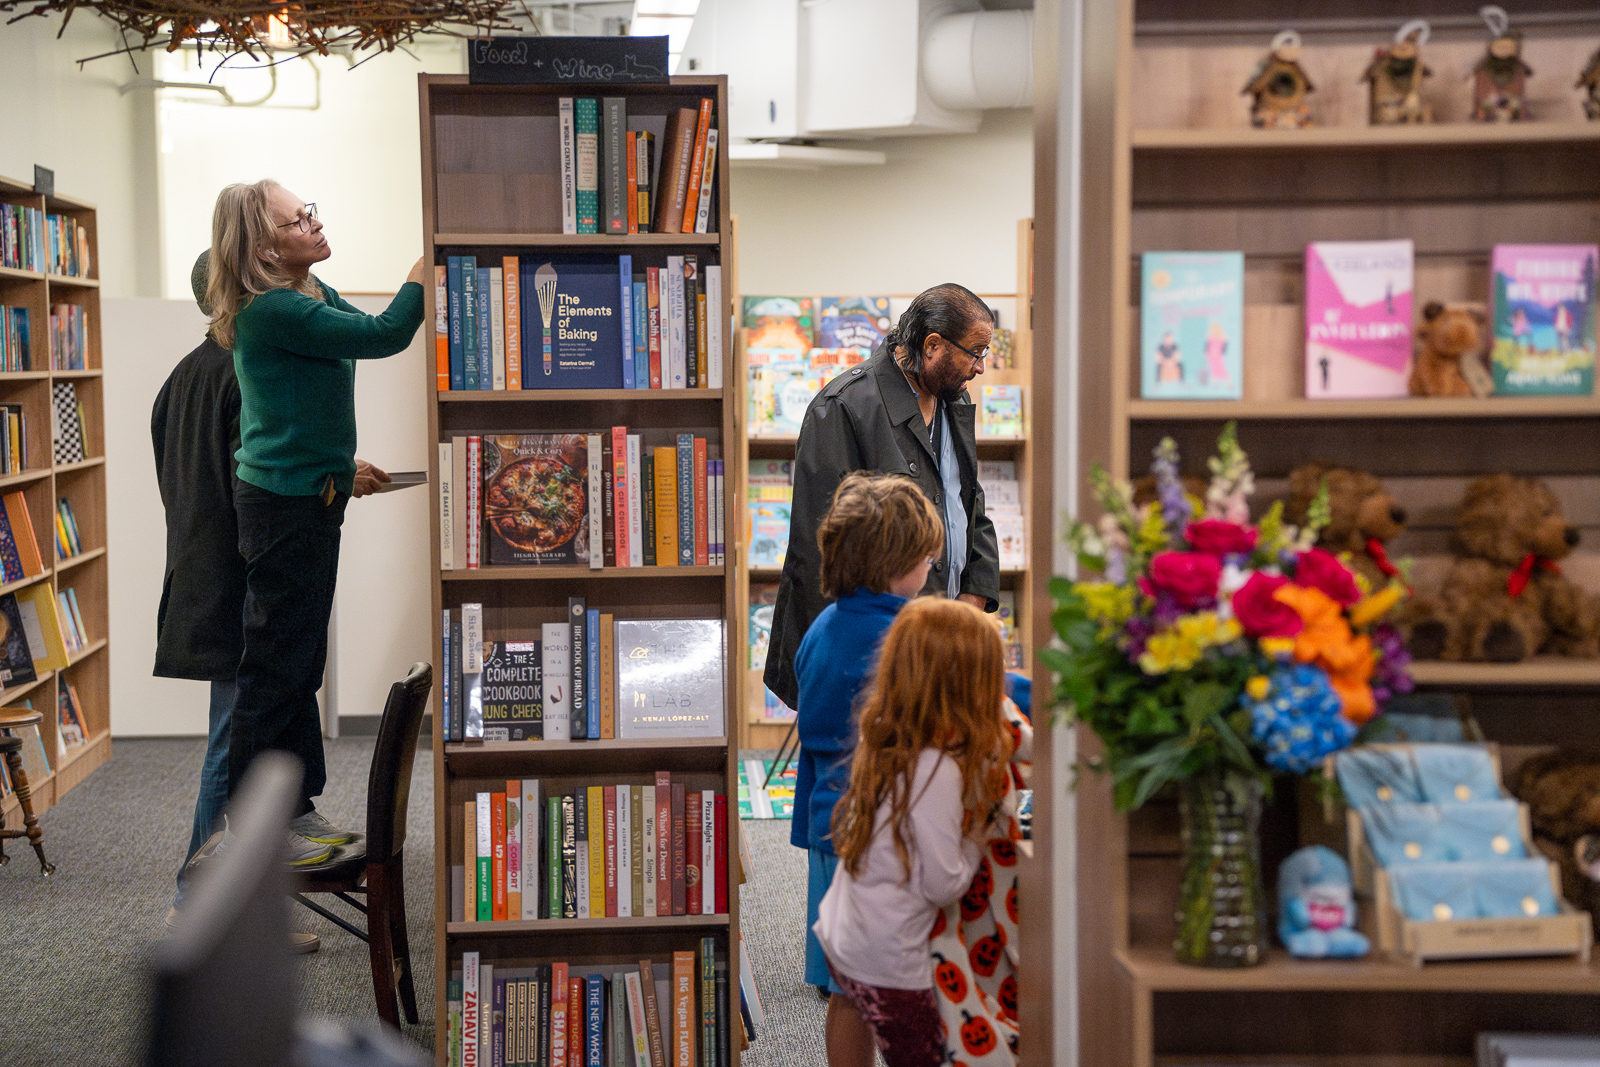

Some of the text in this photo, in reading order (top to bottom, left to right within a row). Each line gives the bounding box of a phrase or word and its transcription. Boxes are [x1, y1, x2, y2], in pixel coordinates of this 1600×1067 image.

[474, 39, 528, 65] Food
[552, 58, 615, 80] Wine
[611, 105, 621, 217] WHEN SOUTHERN WOMEN COOK
[682, 129, 692, 163] ANTHONY
[676, 164, 687, 209] BOURDAIN'S
[465, 276, 473, 292] well
[557, 293, 580, 305] The
[464, 293, 475, 317] plated
[493, 300, 501, 327] Dinner
[558, 305, 612, 316] Elements
[494, 329, 501, 337] in
[507, 273, 518, 372] CHINESE ENOUGH
[558, 317, 570, 328] of
[558, 328, 598, 342] Baking
[650, 308, 660, 352] health nut
[513, 447, 537, 456] Quick
[544, 447, 563, 456] Cozy
[442, 481, 450, 494] ZOË
[615, 462, 625, 488] LULA
[630, 472, 638, 500] Cooking
[604, 471, 613, 517] go-to dinners
[618, 511, 627, 549] COOKBOOK
[683, 509, 691, 541] KITCHEN
[468, 615, 478, 669] Six Seasons
[487, 667, 542, 682] COMPLETE
[513, 655, 527, 664] THE
[574, 625, 582, 709] BIG BOOK OF BREAD
[485, 685, 542, 701] COOKBOOK
[652, 694, 692, 708] LAB
[485, 704, 542, 719] UNG CHEFS
[526, 813, 534, 861] OTTOLENGHI
[566, 803, 575, 847] WINE FOLLY
[659, 808, 667, 837] What's
[704, 822, 713, 843] Night
[508, 801, 518, 889] Ottolenghi COMFORT
[593, 832, 601, 875] ROBERTS
[607, 809, 616, 888] Italian American
[633, 830, 641, 875] PLANTAS
[675, 820, 683, 880] BEAN BOOK
[645, 858, 653, 883] Simple
[464, 990, 477, 1040] ZAHAV
[482, 1003, 490, 1045] Martha
[571, 984, 579, 1049] STANLEY TUCCI
[591, 988, 600, 1066] THE NEW WHOLE
[678, 976, 689, 1066] BIG Vegan FLAVOR
[652, 1032, 662, 1066] Kitchen
